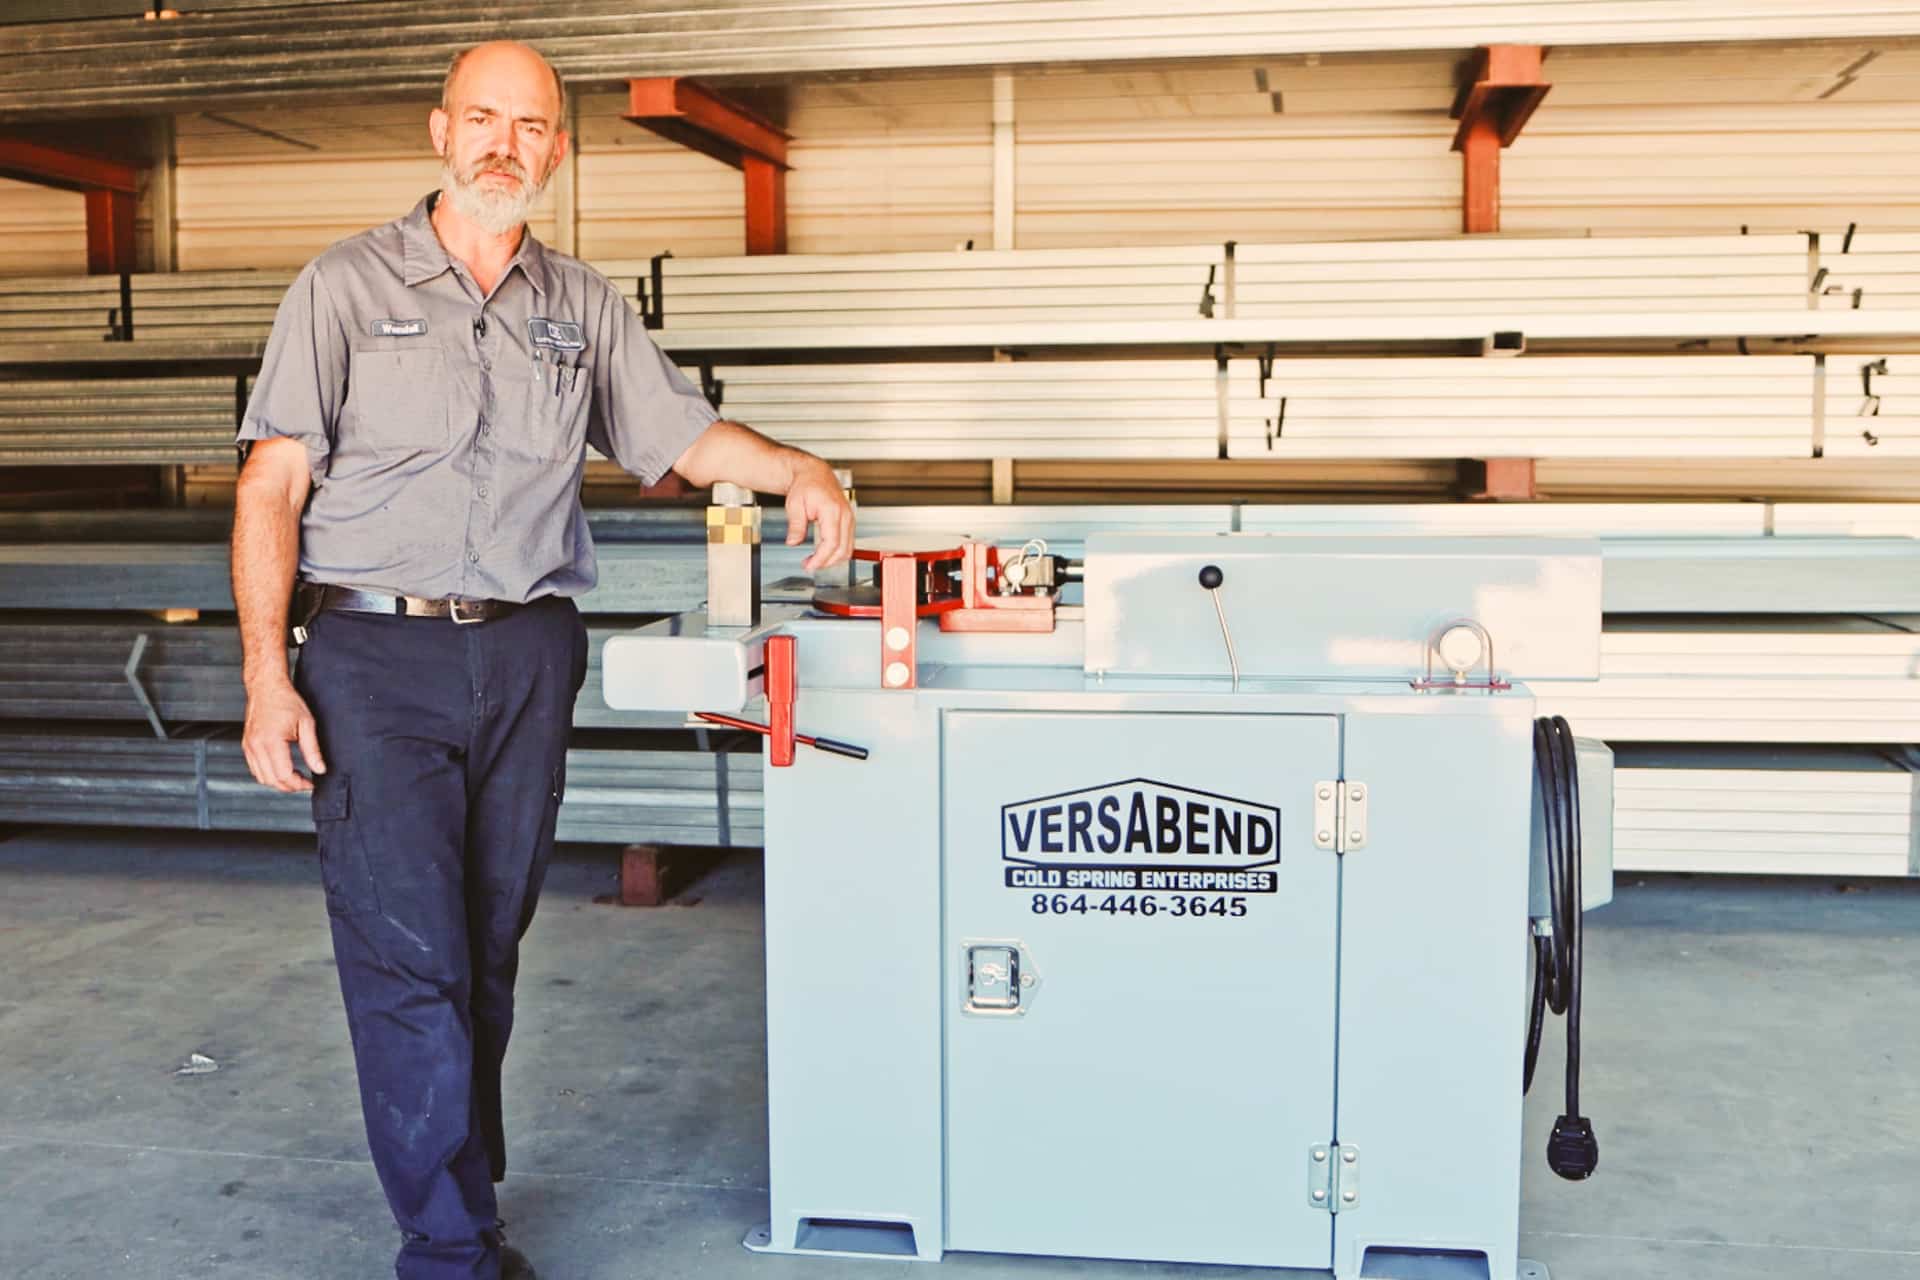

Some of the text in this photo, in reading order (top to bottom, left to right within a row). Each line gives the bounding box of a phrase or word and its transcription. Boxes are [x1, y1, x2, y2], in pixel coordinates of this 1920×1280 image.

[1008, 791, 1274, 856] VERSABEND
[1012, 869, 1271, 890] COLD SPRING ENTERPRISES
[1031, 893, 1248, 917] 864-446-3645
